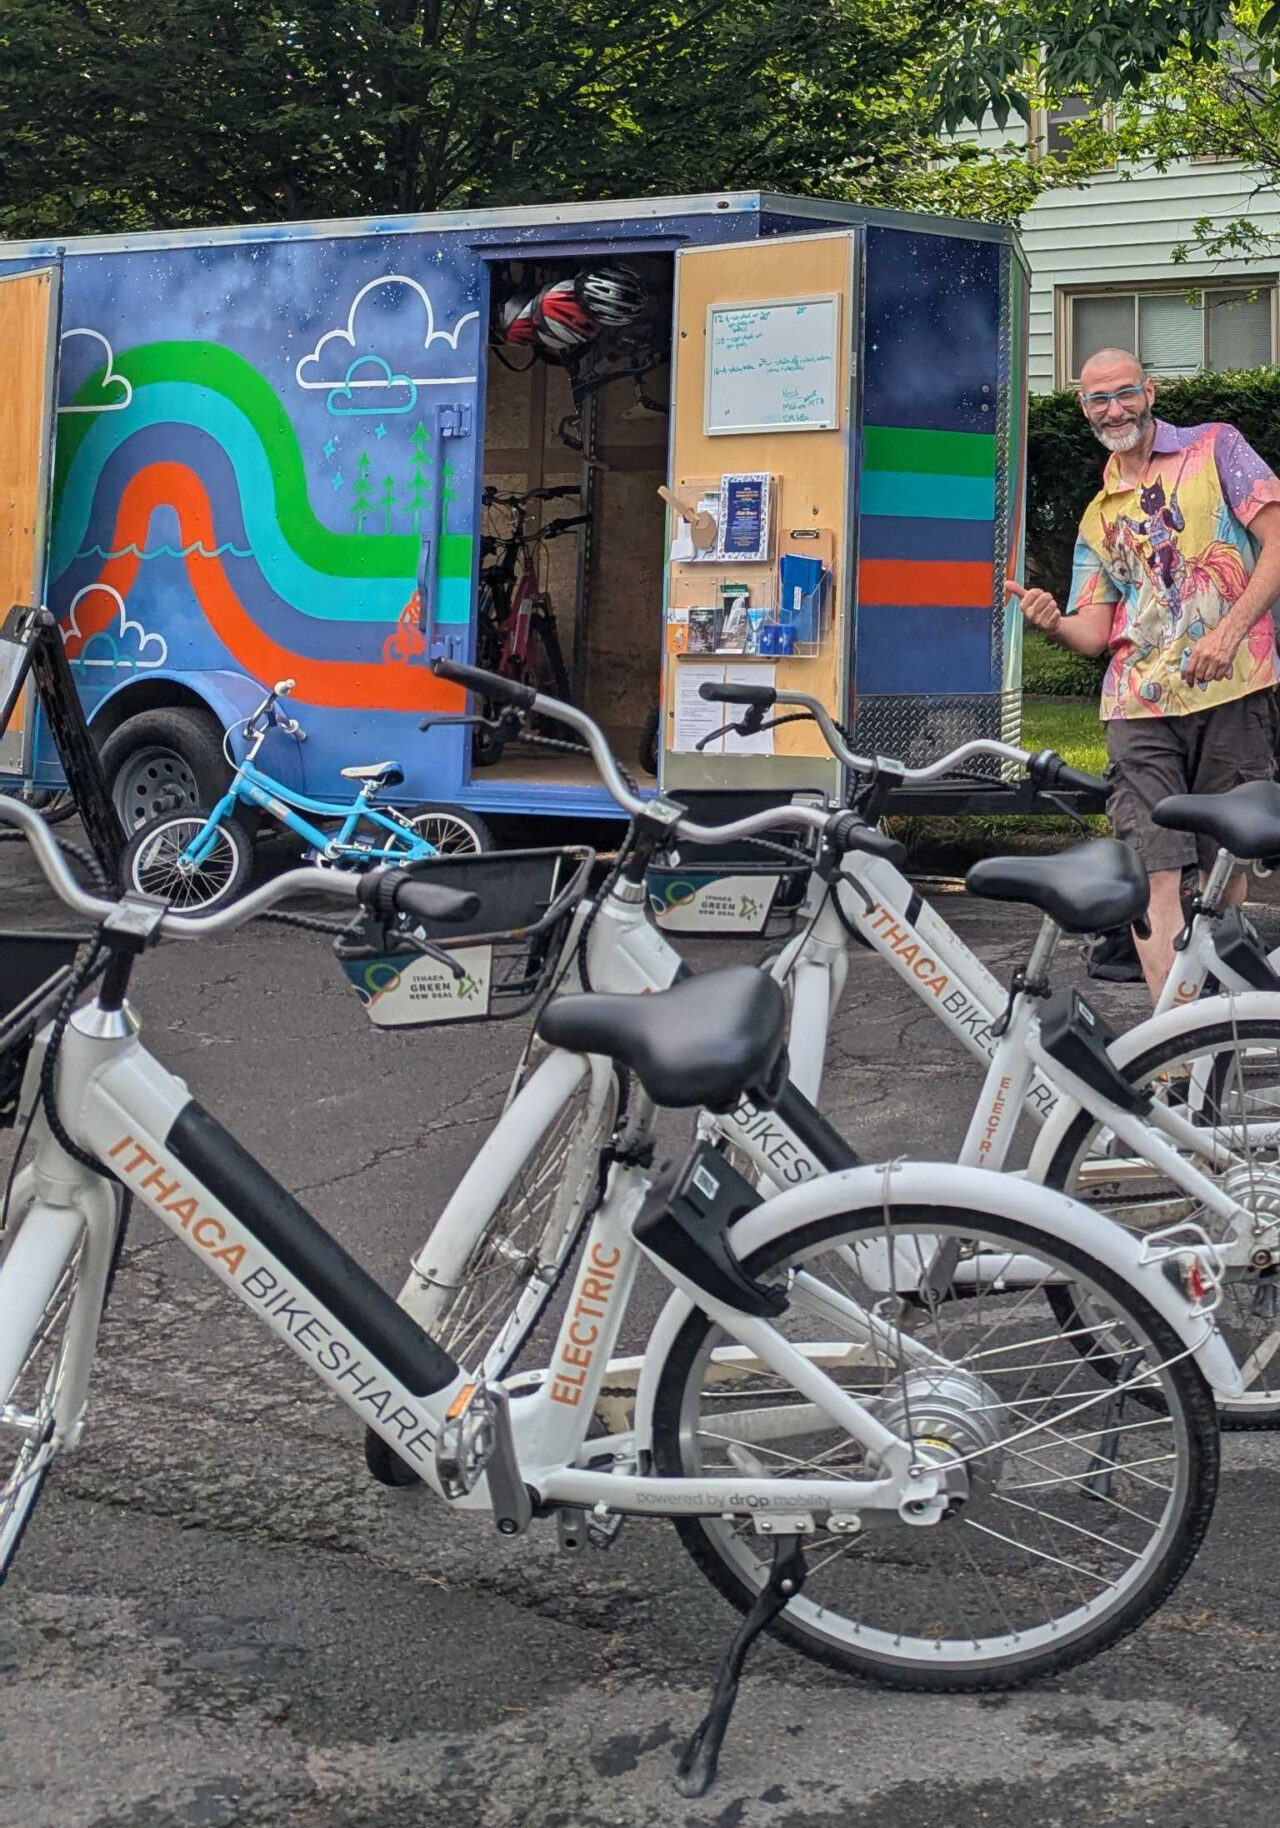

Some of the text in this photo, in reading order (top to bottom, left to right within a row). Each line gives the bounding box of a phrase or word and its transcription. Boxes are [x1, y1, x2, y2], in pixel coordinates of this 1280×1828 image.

[700, 901, 736, 910] GREEN
[412, 975, 445, 983] ITHACA
[409, 983, 451, 992] GREEN
[977, 1076, 1012, 1166] ELECTRI
[107, 1133, 438, 1463] ITHACA BIKESHARE
[549, 1242, 622, 1408] ELECTRIC
[635, 1492, 702, 1505] powered
[706, 1492, 725, 1508] by
[773, 1493, 832, 1507] mobility
